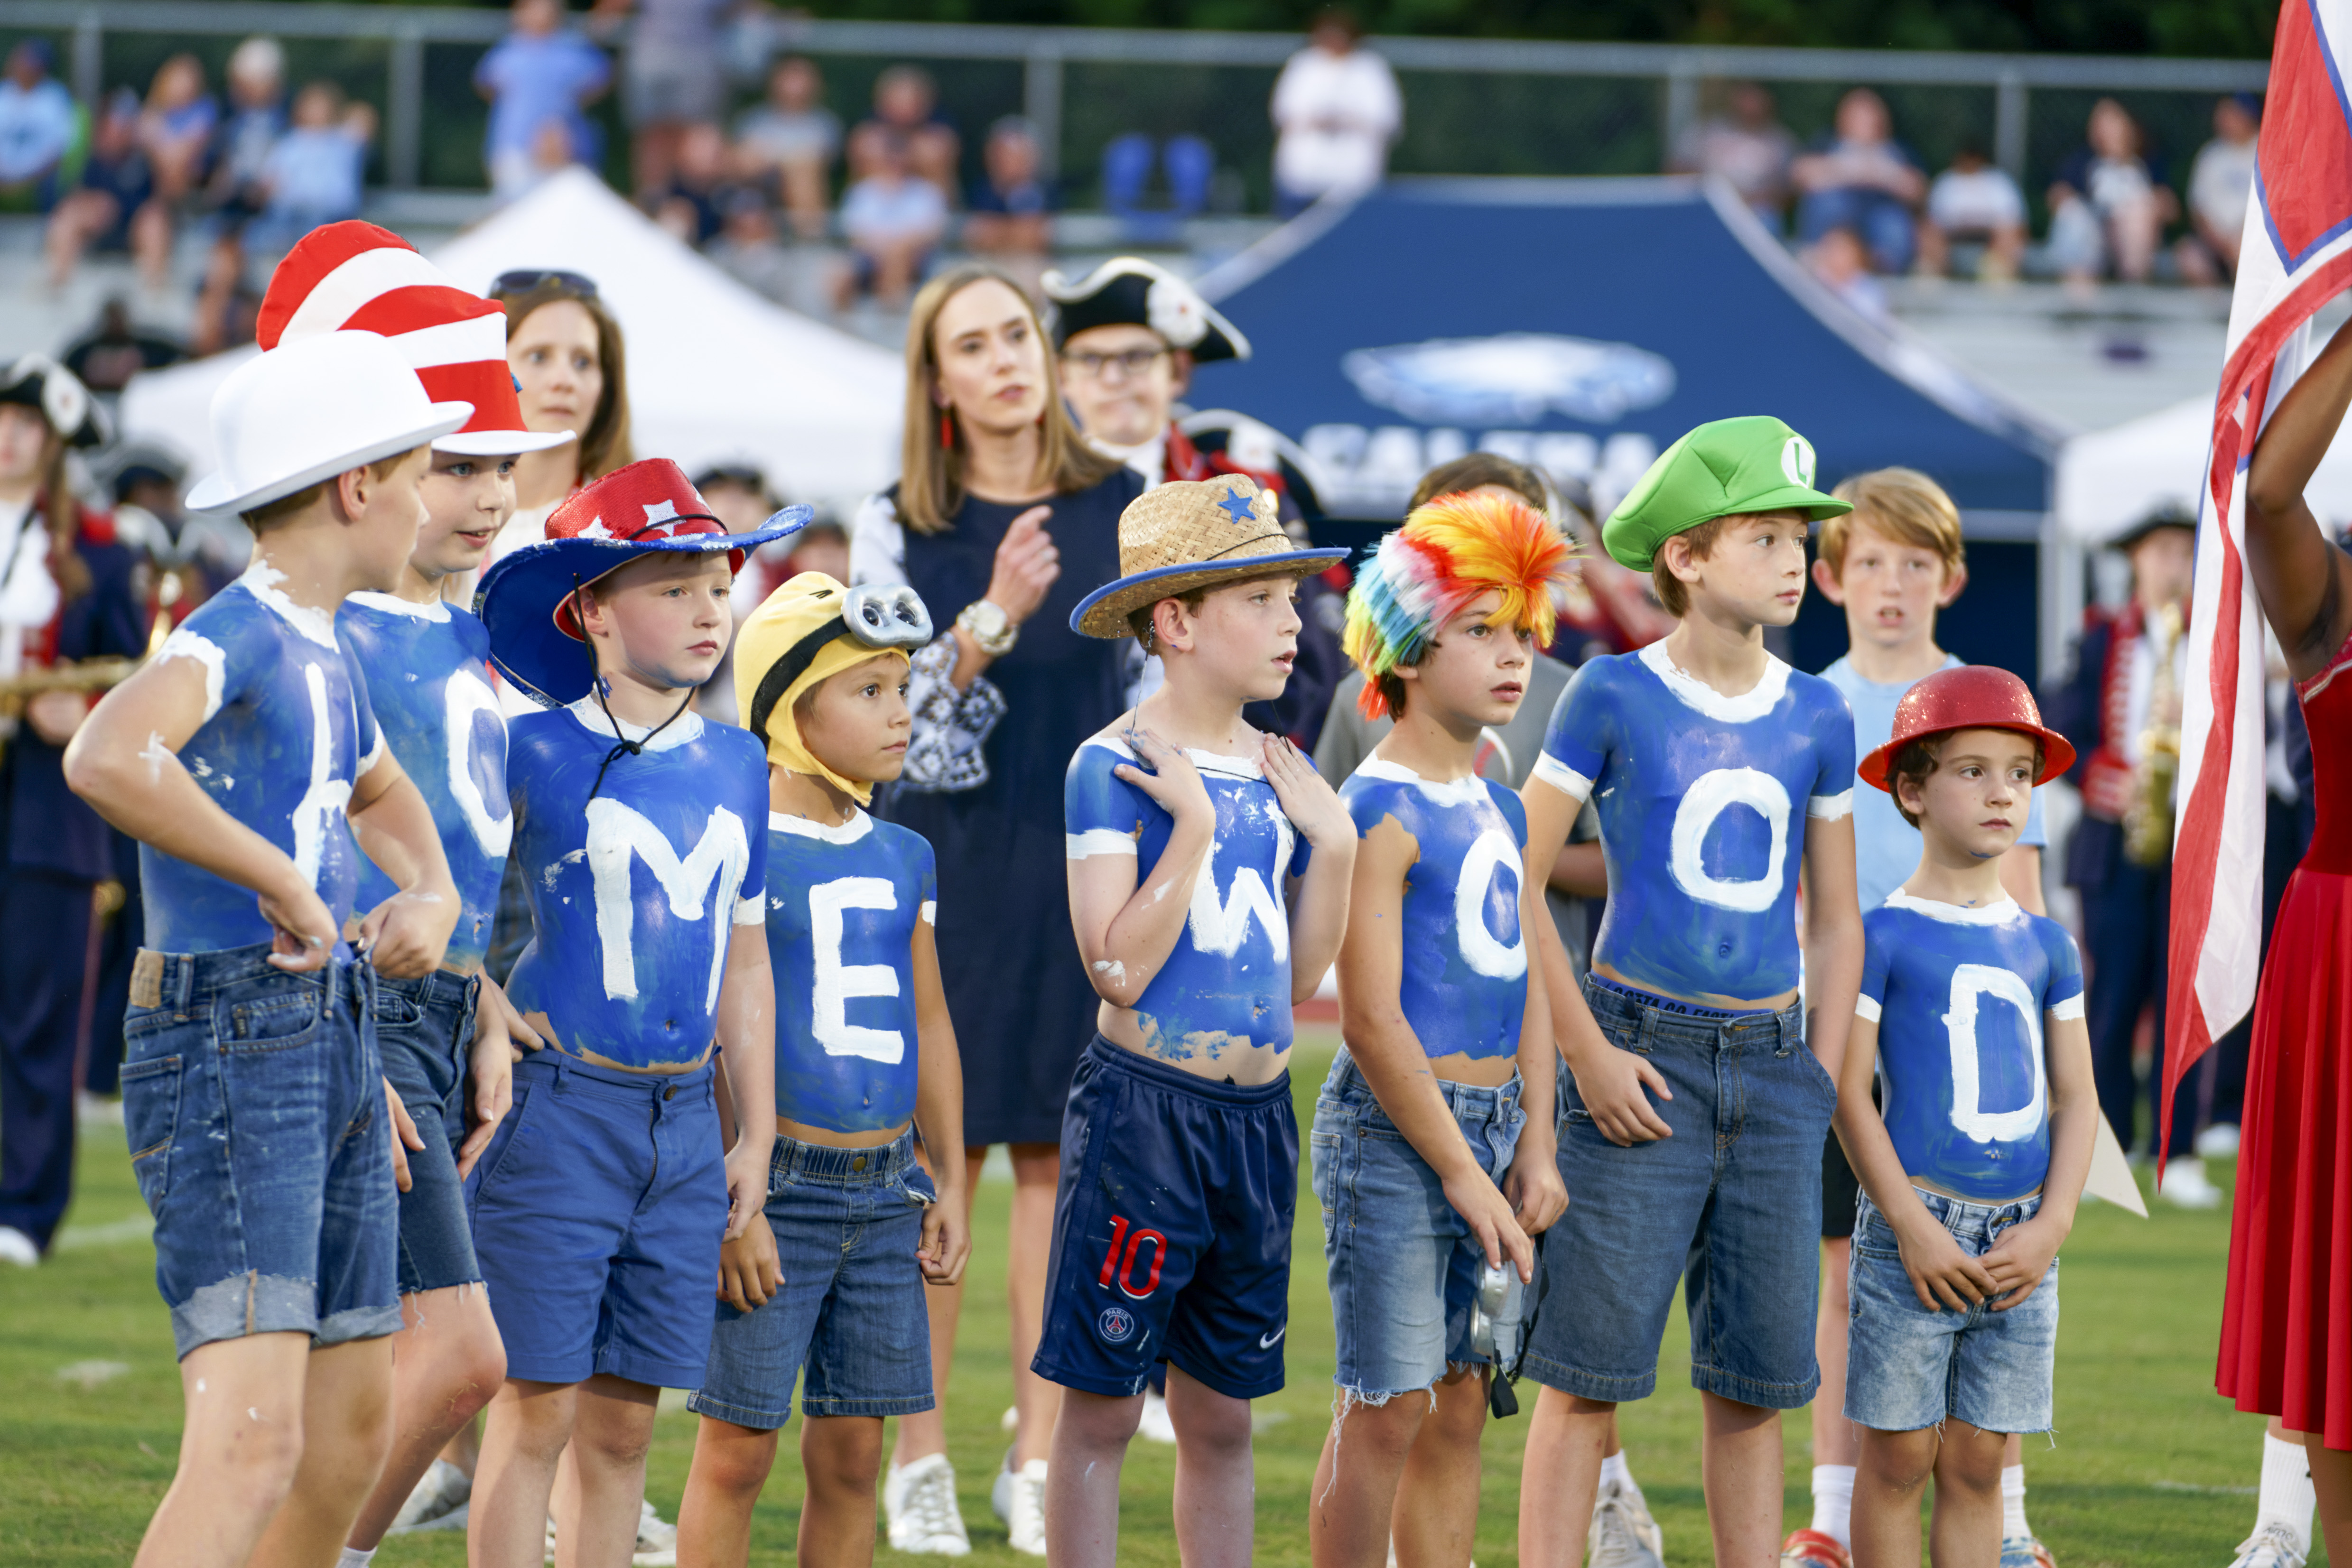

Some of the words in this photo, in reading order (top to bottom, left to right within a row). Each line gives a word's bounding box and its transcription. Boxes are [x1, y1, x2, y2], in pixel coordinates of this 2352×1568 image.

[1794, 442, 1807, 485] L
[445, 668, 513, 858] O
[1667, 766, 1792, 912] O
[585, 797, 749, 1016] M
[1189, 794, 1294, 964] W
[1456, 829, 1527, 981] O
[809, 876, 904, 1064] E
[1941, 964, 2046, 1143] D
[1098, 1214, 1168, 1300] 10
[1106, 1309, 1129, 1319] PARIS
